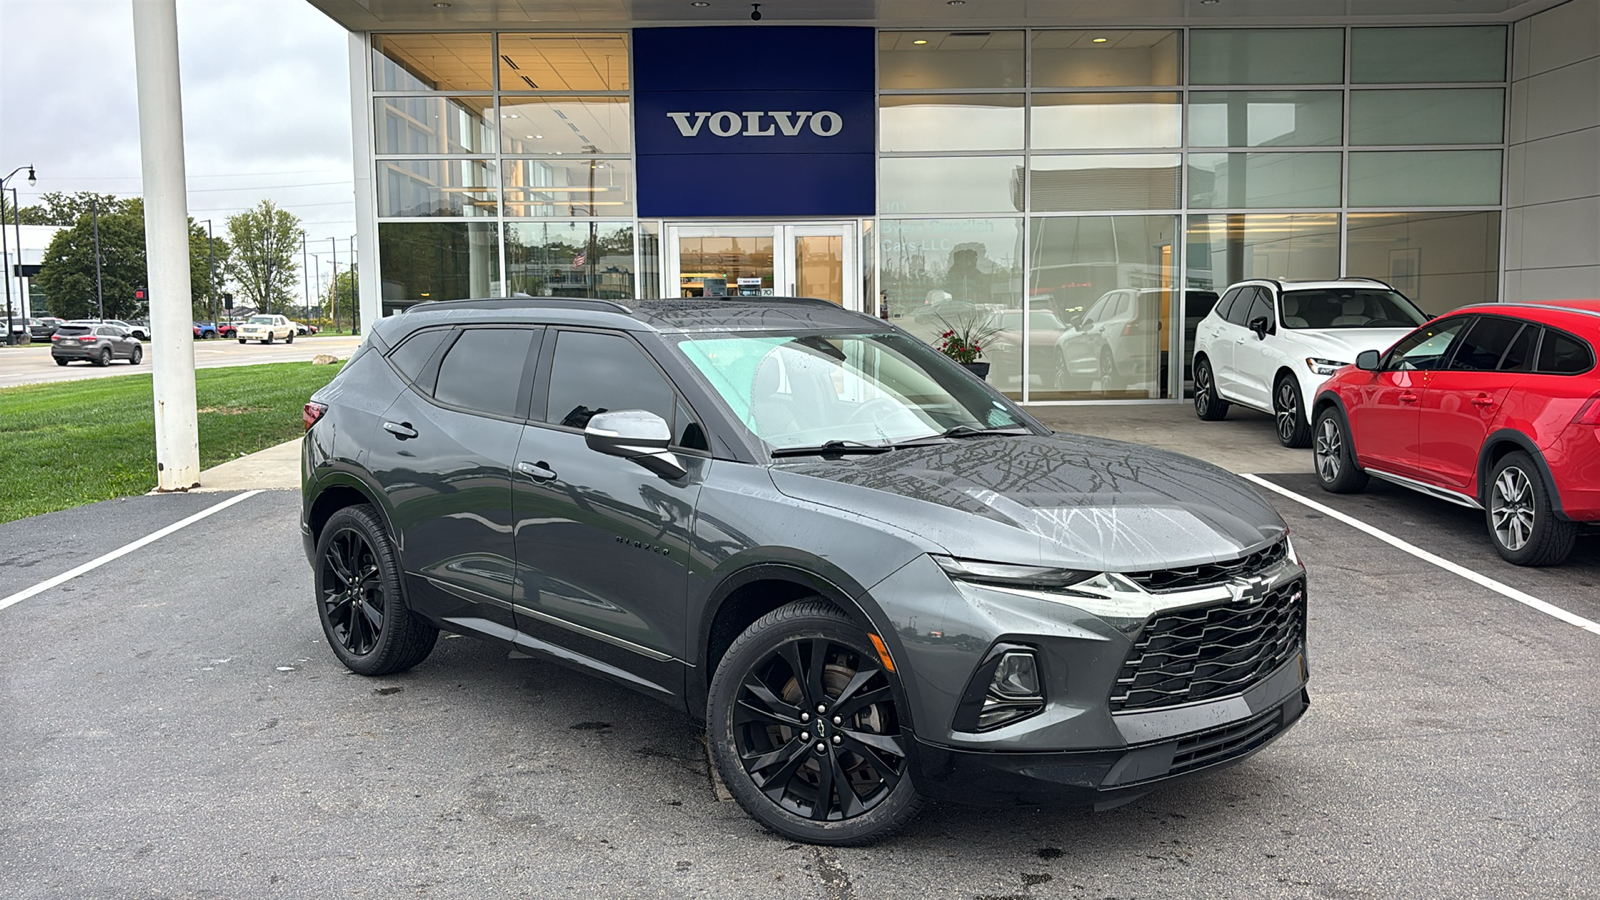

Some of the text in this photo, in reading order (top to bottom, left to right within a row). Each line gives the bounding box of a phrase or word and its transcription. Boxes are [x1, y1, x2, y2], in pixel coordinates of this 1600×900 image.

[666, 111, 843, 137] VOLVO
[881, 239, 952, 252] Cars LLC
